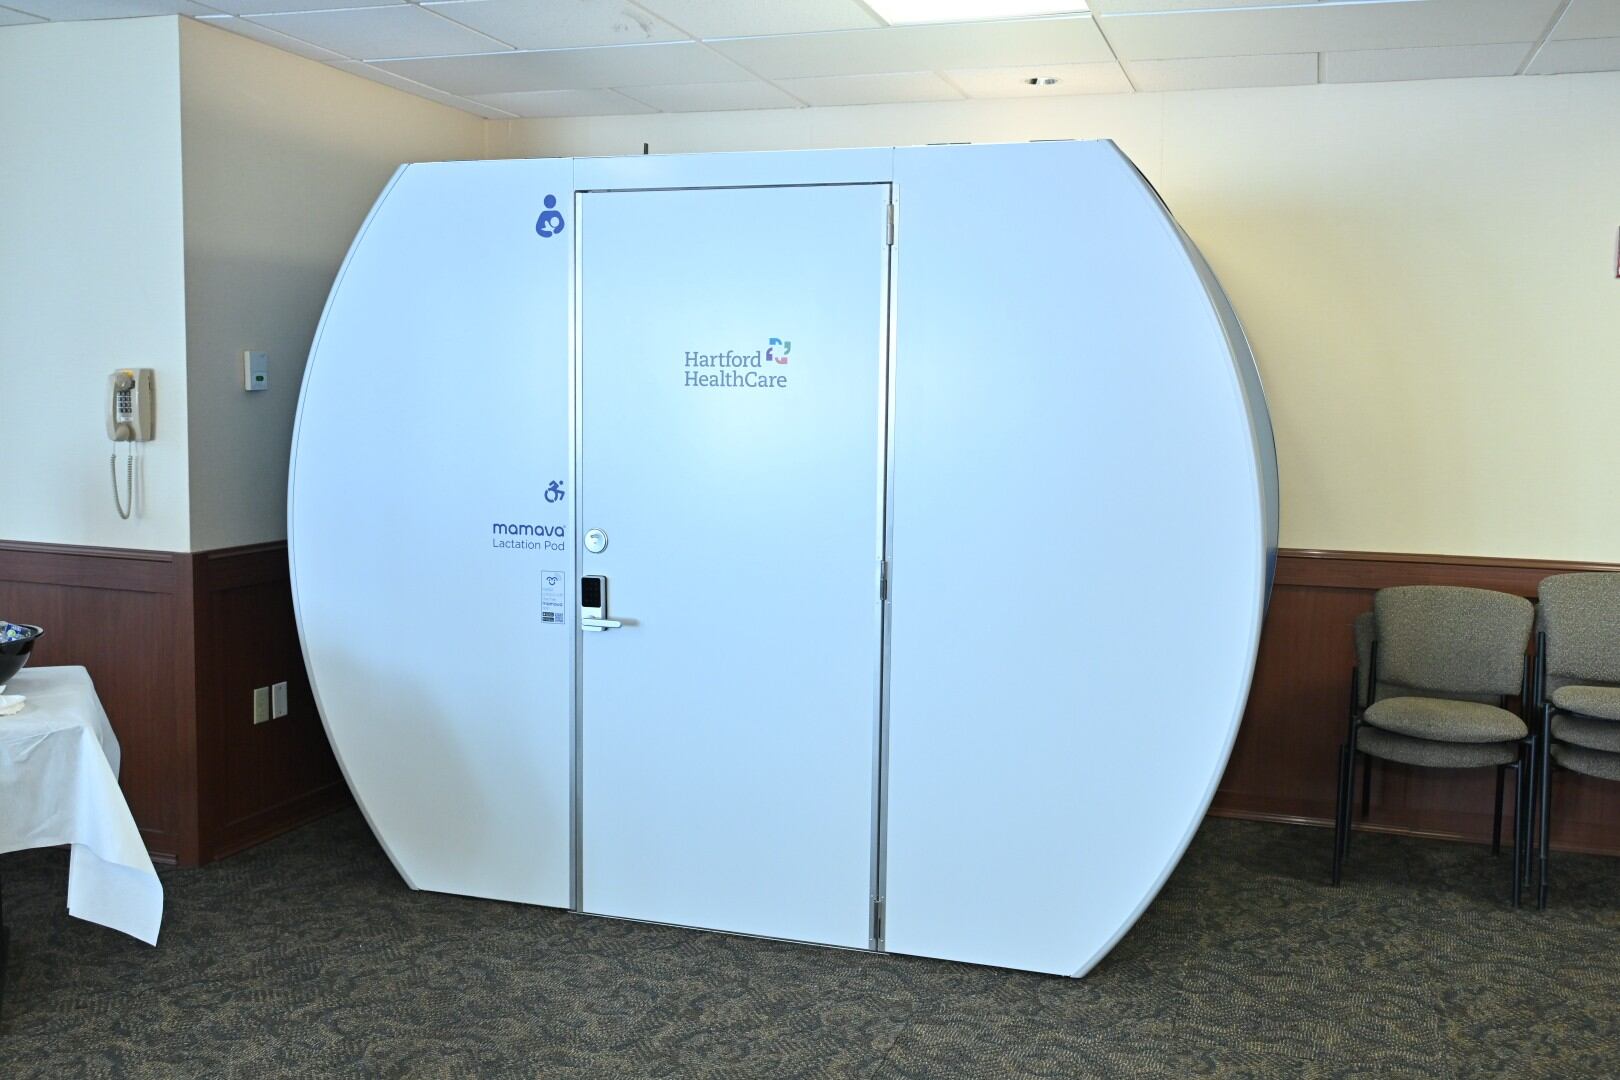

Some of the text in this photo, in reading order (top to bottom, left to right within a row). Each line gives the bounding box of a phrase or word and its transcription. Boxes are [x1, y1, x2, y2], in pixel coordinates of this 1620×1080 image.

[684, 350, 761, 367] Hartford
[684, 370, 787, 388] HealthCare
[493, 523, 565, 537] mamava
[493, 538, 565, 551] Lactation Pod
